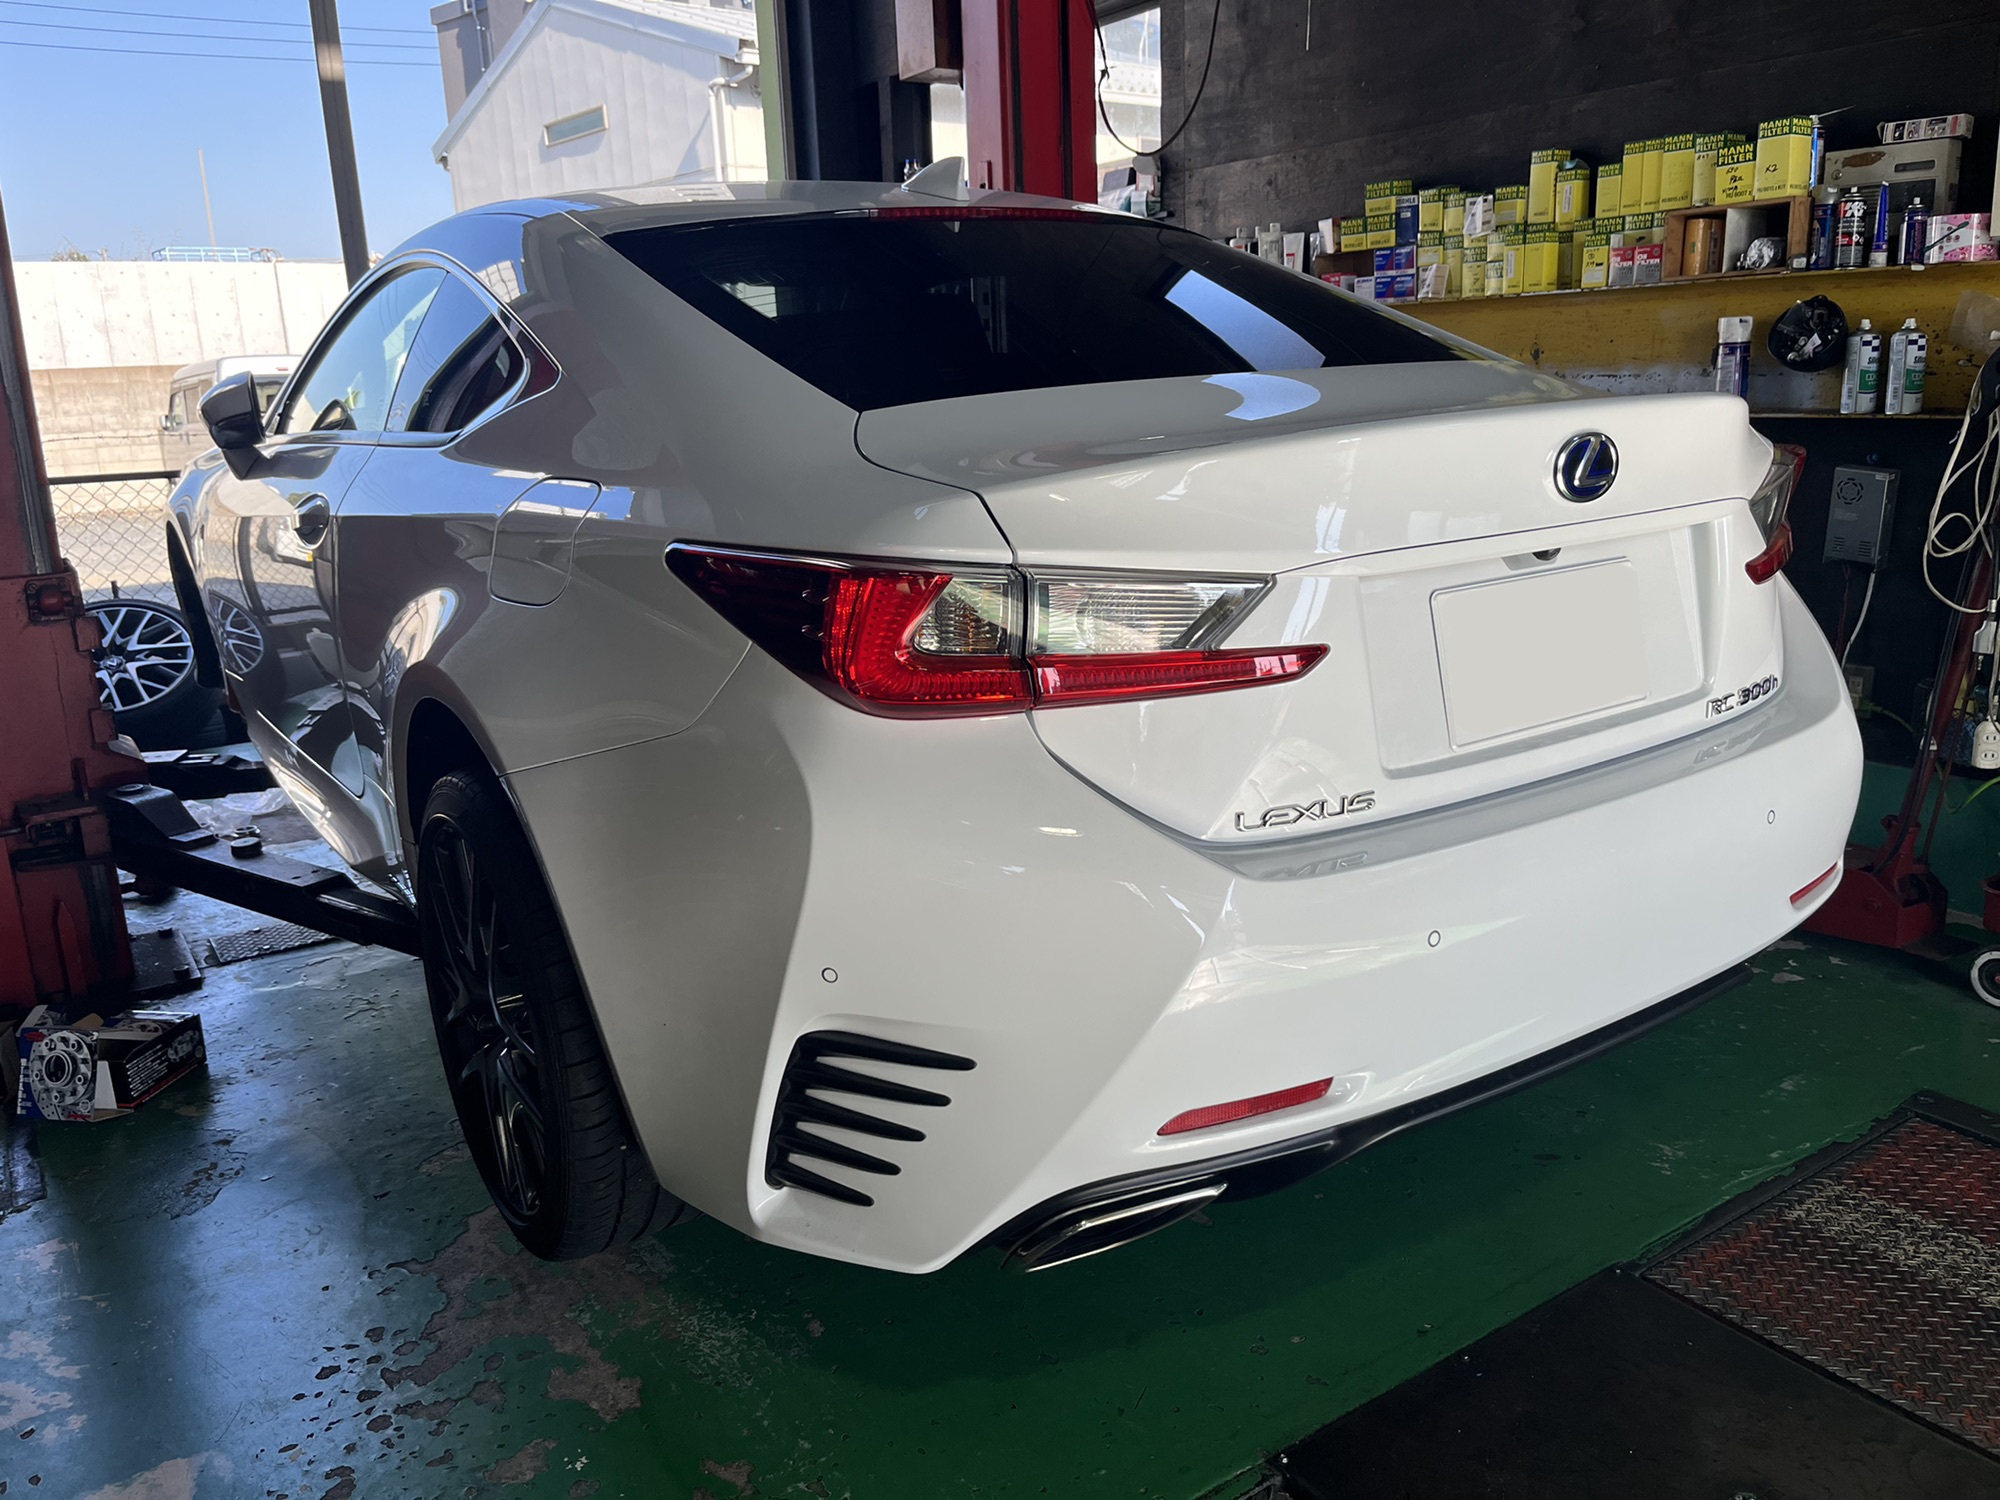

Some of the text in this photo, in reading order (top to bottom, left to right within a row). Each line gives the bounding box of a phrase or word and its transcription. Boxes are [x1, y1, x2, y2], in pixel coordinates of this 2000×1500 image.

[1760, 118, 1790, 130] MANN
[1793, 118, 1812, 127] MANN
[1760, 127, 1790, 137] FILTER
[1793, 126, 1811, 134] FILTER
[1665, 134, 1693, 144] MANN
[1696, 134, 1725, 145] MANN
[1665, 141, 1693, 151] FILTER
[1696, 142, 1724, 152] FILTER
[1719, 143, 1754, 157] MANN
[1532, 155, 1552, 163] FILTER
[1718, 153, 1753, 165] FILTER
[1366, 181, 1391, 190] MANN
[1393, 186, 1412, 194] FILTER
[1495, 186, 1518, 194] MANN
[1366, 189, 1391, 198] FILTER
[1496, 191, 1517, 200] FILTER
[1341, 219, 1363, 227] MANN
[1367, 215, 1391, 224] MANN
[1596, 218, 1623, 228] MANN
[1626, 214, 1652, 223] MANN
[1654, 218, 1665, 226] FIL
[1367, 222, 1390, 232] FILTER
[1596, 225, 1622, 233] FILTER
[1625, 221, 1652, 230] FILTER
[1341, 226, 1363, 235] FILTER
[1420, 238, 1439, 246] FILTER
[1585, 239, 1606, 247] FILTER
[1464, 247, 1487, 255] MANN
[1464, 253, 1486, 262] FILTER
[1706, 673, 1778, 718] RC 300h
[1234, 789, 1376, 832] LEXUS
